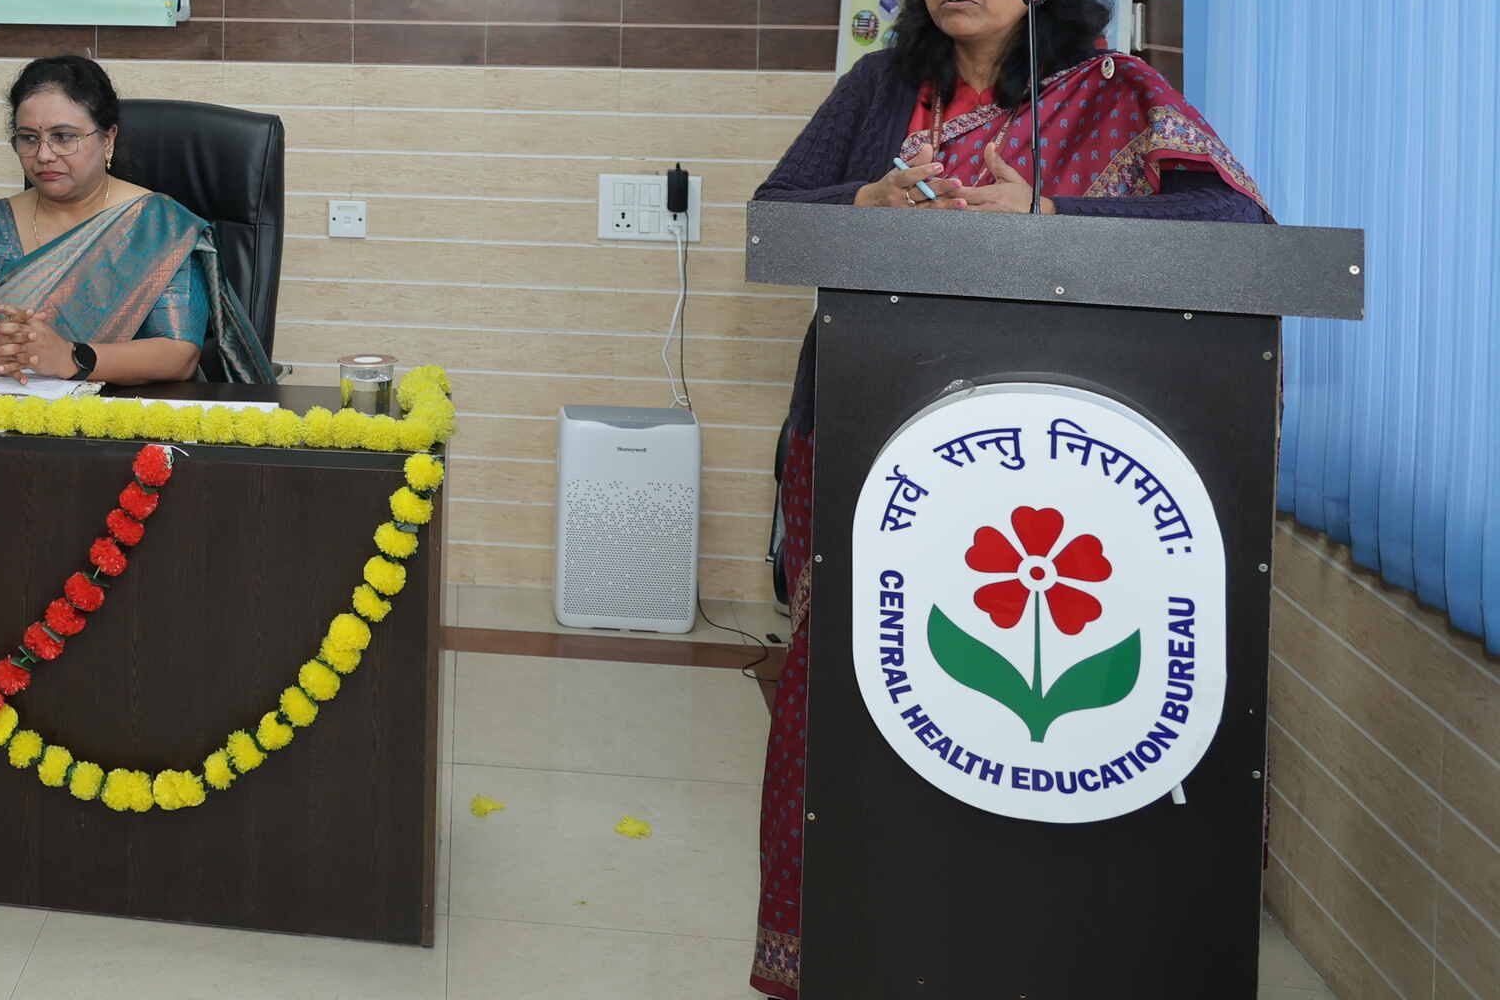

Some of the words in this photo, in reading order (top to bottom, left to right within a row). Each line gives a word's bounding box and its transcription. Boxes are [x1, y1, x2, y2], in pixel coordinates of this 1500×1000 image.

[932, 426, 1026, 471] सन्तु
[879, 569, 911, 704] CENTRAL
[900, 703, 1004, 786] HEALTH
[1010, 721, 1179, 795] EDUCATION
[1161, 596, 1196, 725] BUREAU
